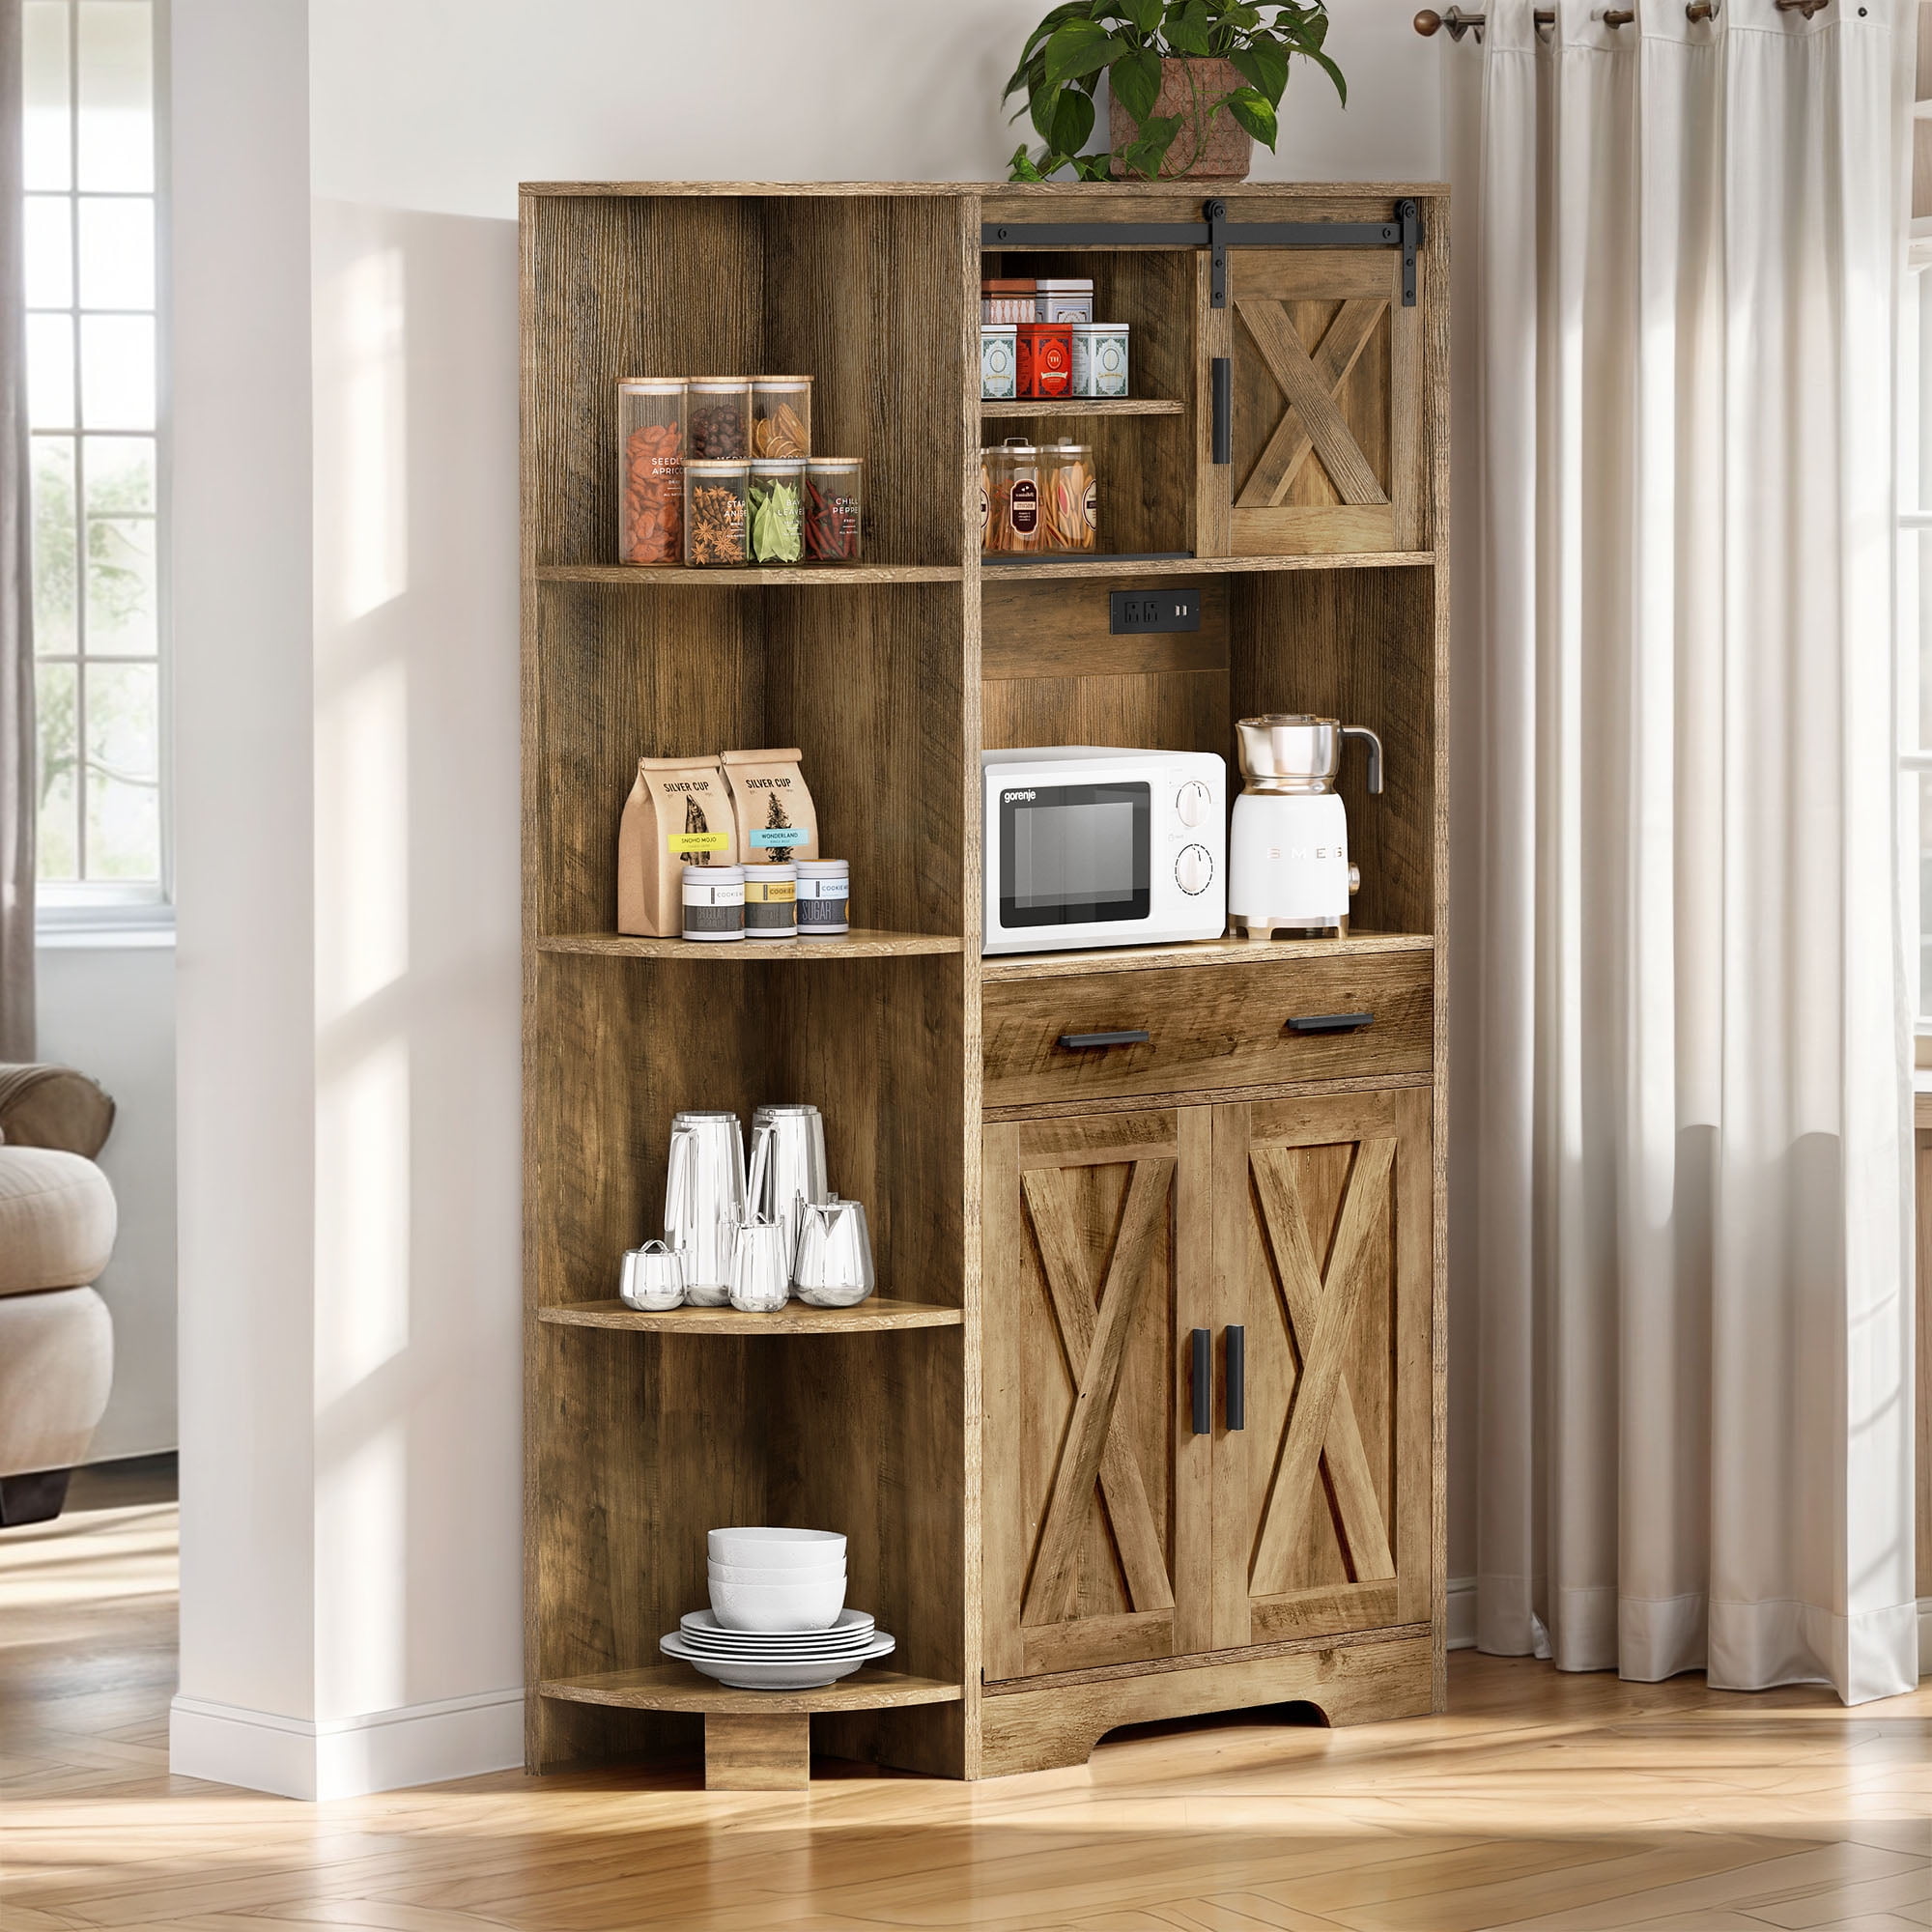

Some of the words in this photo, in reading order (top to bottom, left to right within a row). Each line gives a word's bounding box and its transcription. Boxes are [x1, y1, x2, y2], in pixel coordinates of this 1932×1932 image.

[786, 498, 801, 507] BAY
[663, 782, 692, 793] SILVER
[693, 781, 710, 791] CUP
[746, 779, 774, 789] SILVER
[775, 778, 792, 788] CUP
[1004, 788, 1037, 804] gorenje
[1268, 846, 1344, 860] SMEG
[802, 900, 833, 921] SUGAR
